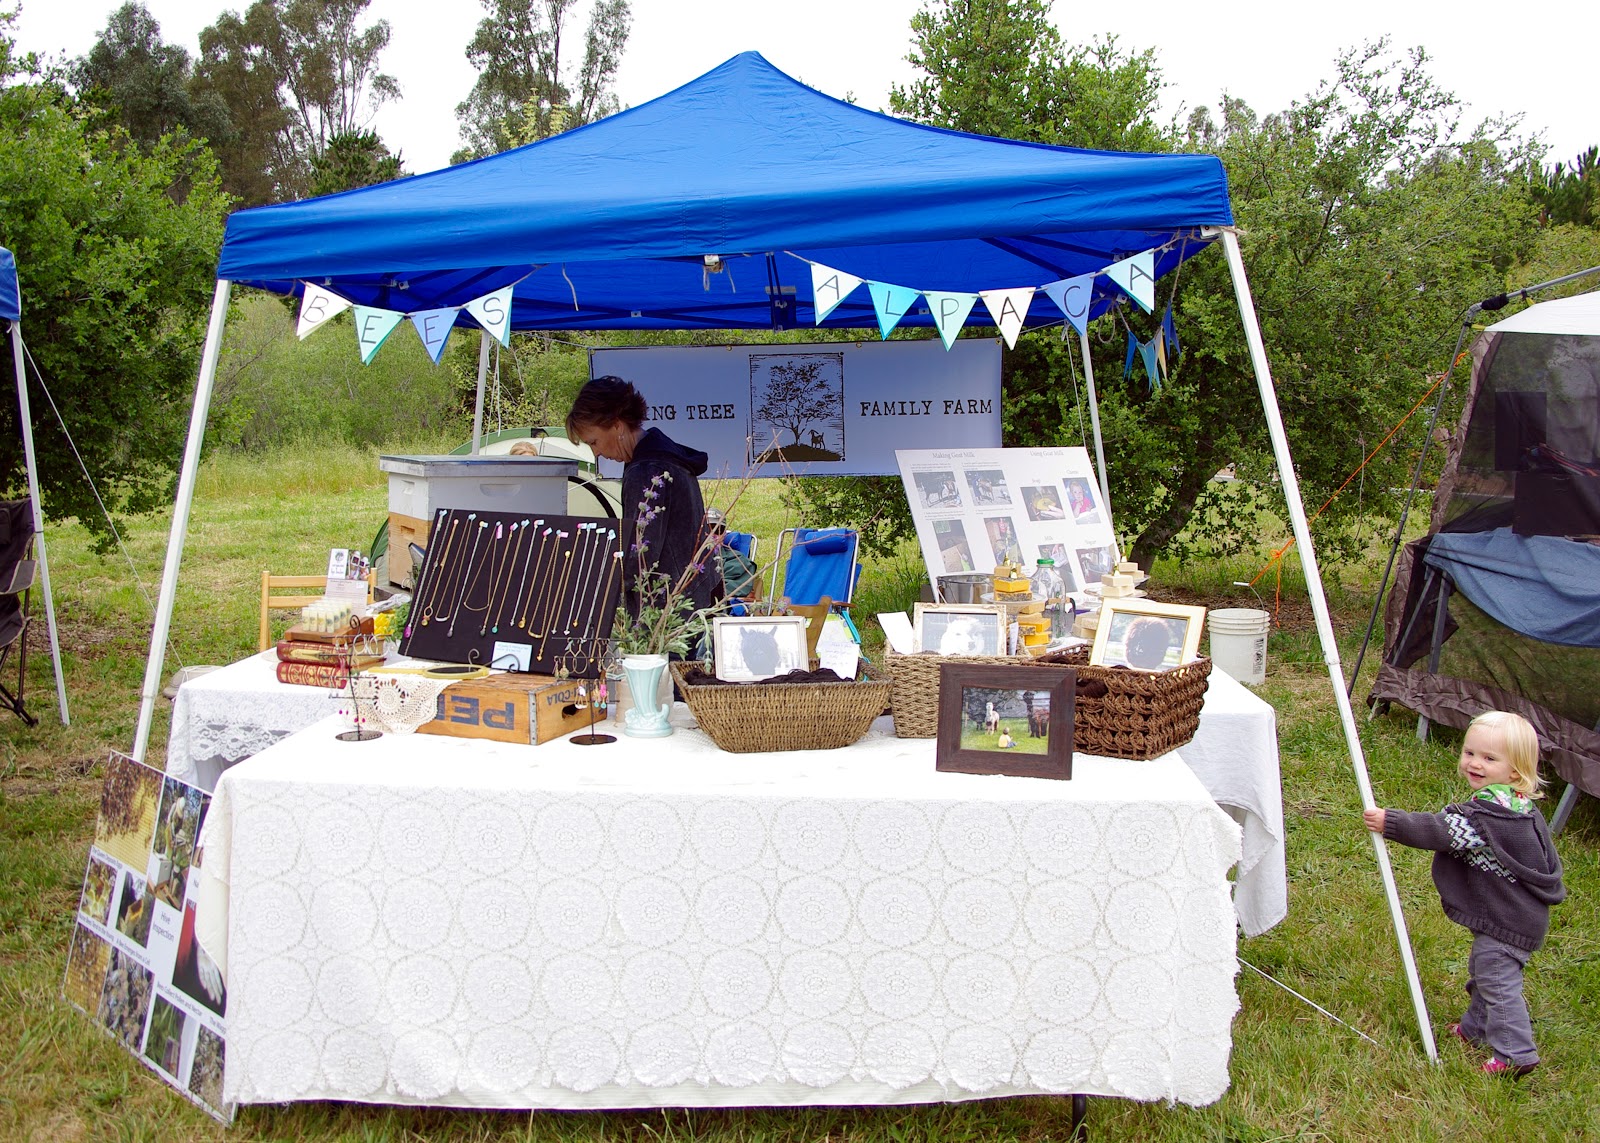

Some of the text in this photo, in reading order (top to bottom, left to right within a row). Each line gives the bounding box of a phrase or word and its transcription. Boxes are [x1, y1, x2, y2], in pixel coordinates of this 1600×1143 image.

[816, 263, 1154, 331] ALPACA
[301, 295, 505, 345] BEES
[686, 403, 735, 420] TREE
[860, 399, 993, 417] FAMILY FARM
[160, 911, 171, 925] Hive
[152, 921, 175, 943] Inspection
